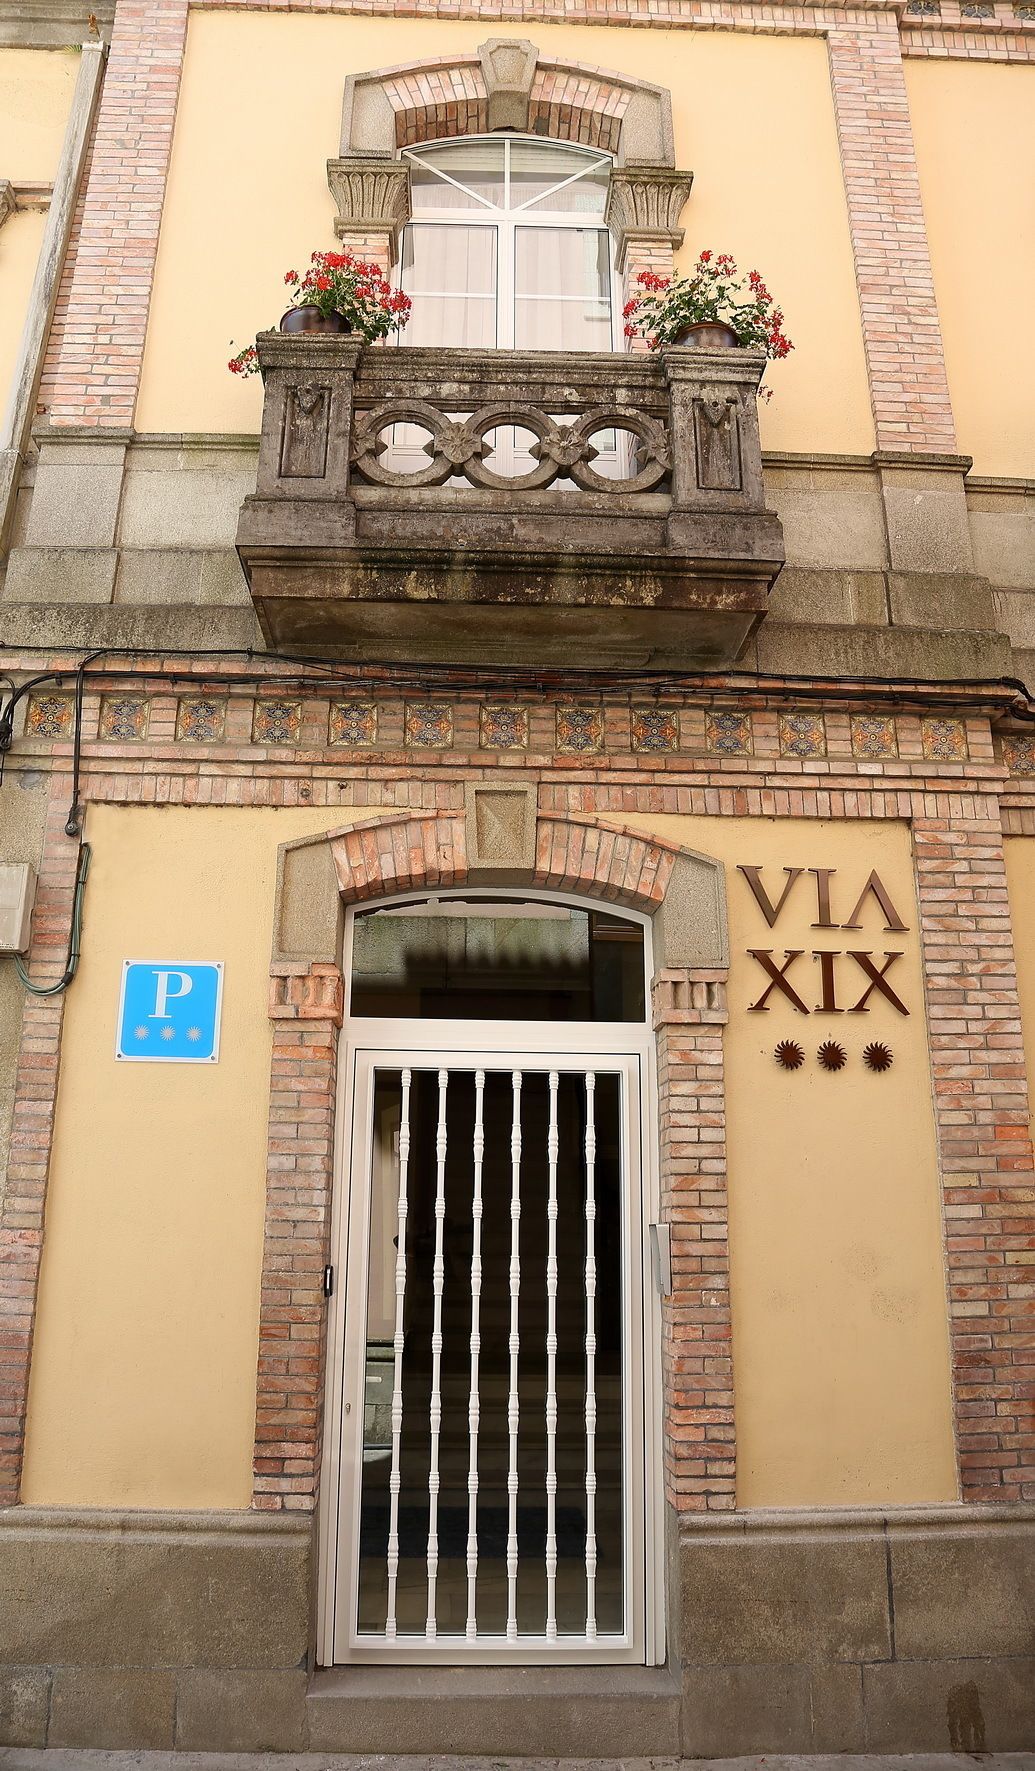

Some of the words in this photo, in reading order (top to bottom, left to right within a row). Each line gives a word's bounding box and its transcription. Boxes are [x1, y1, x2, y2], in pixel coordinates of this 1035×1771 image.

[736, 864, 910, 932] VIA
[148, 970, 193, 1018] P
[746, 949, 910, 1016] XIX
